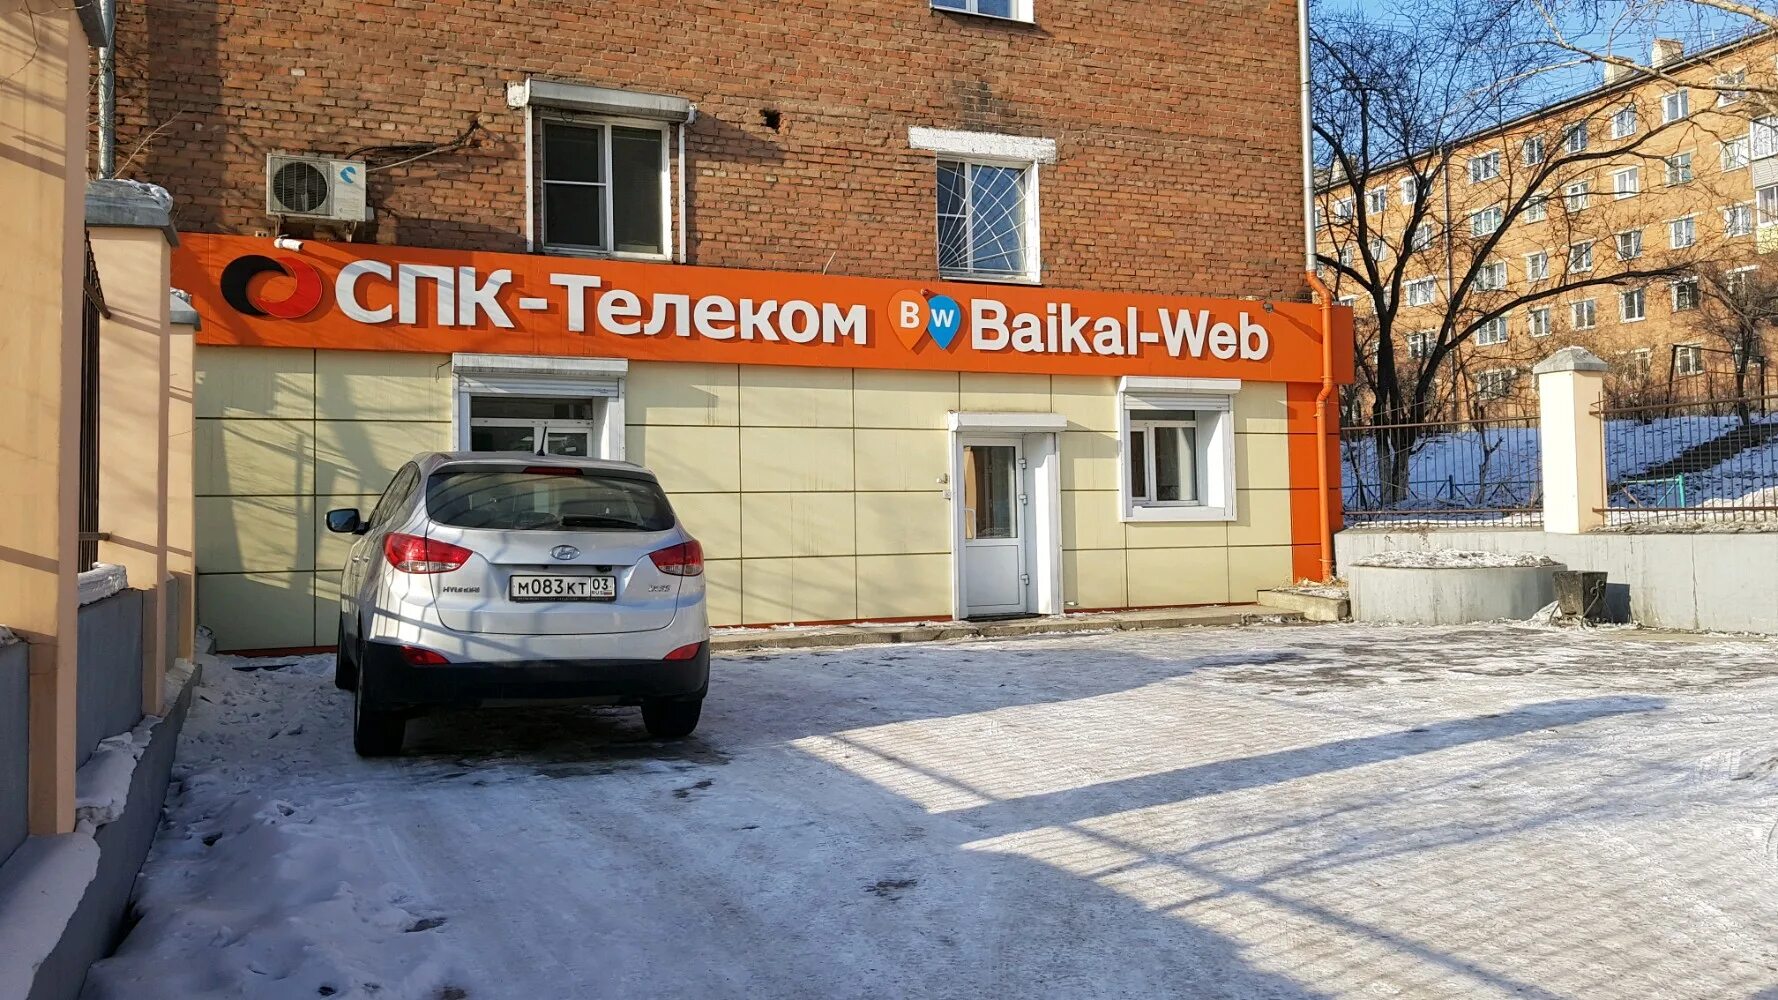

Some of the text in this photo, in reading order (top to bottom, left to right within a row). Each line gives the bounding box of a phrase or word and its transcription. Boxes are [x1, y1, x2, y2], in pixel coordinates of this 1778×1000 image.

[335, 259, 867, 346] СПК-Телеком
[971, 299, 1269, 361] Baikal-Web
[592, 578, 608, 590] 03
